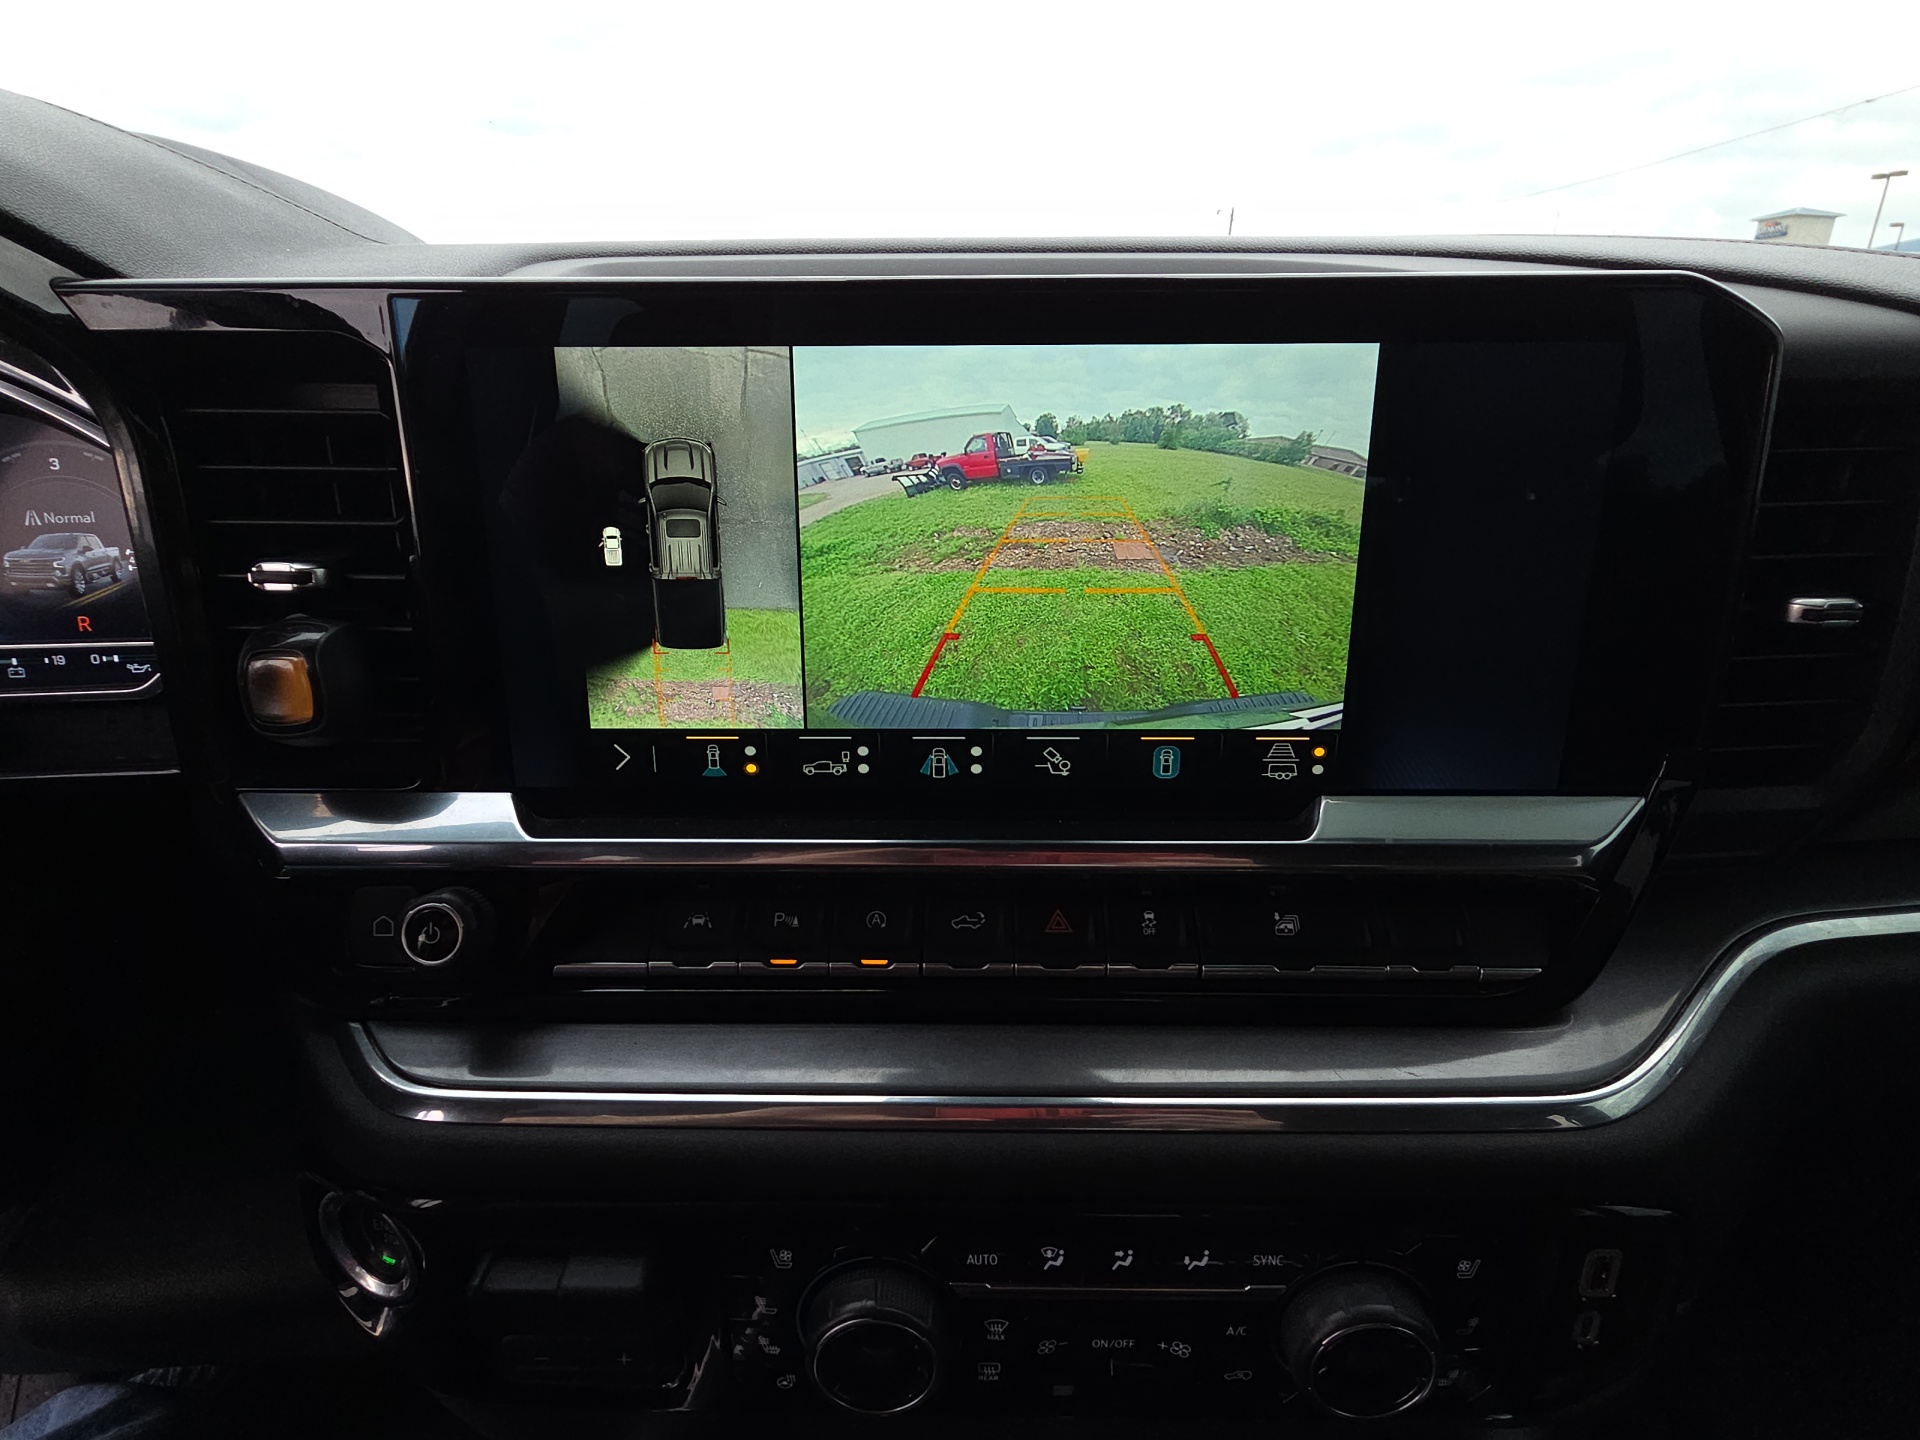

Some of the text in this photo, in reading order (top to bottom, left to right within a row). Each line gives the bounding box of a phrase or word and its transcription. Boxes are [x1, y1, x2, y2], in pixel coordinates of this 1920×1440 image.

[48, 457, 60, 470] 3
[44, 511, 95, 525] Normal
[76, 616, 93, 632] R
[51, 655, 66, 665] 19
[90, 654, 100, 665] 0
[1142, 927, 1157, 936] OFF
[966, 1253, 998, 1266] AUTO
[1252, 1254, 1285, 1266] SYNC
[1225, 1326, 1248, 1337] A/C
[1091, 1339, 1137, 1349] ON/OFF
